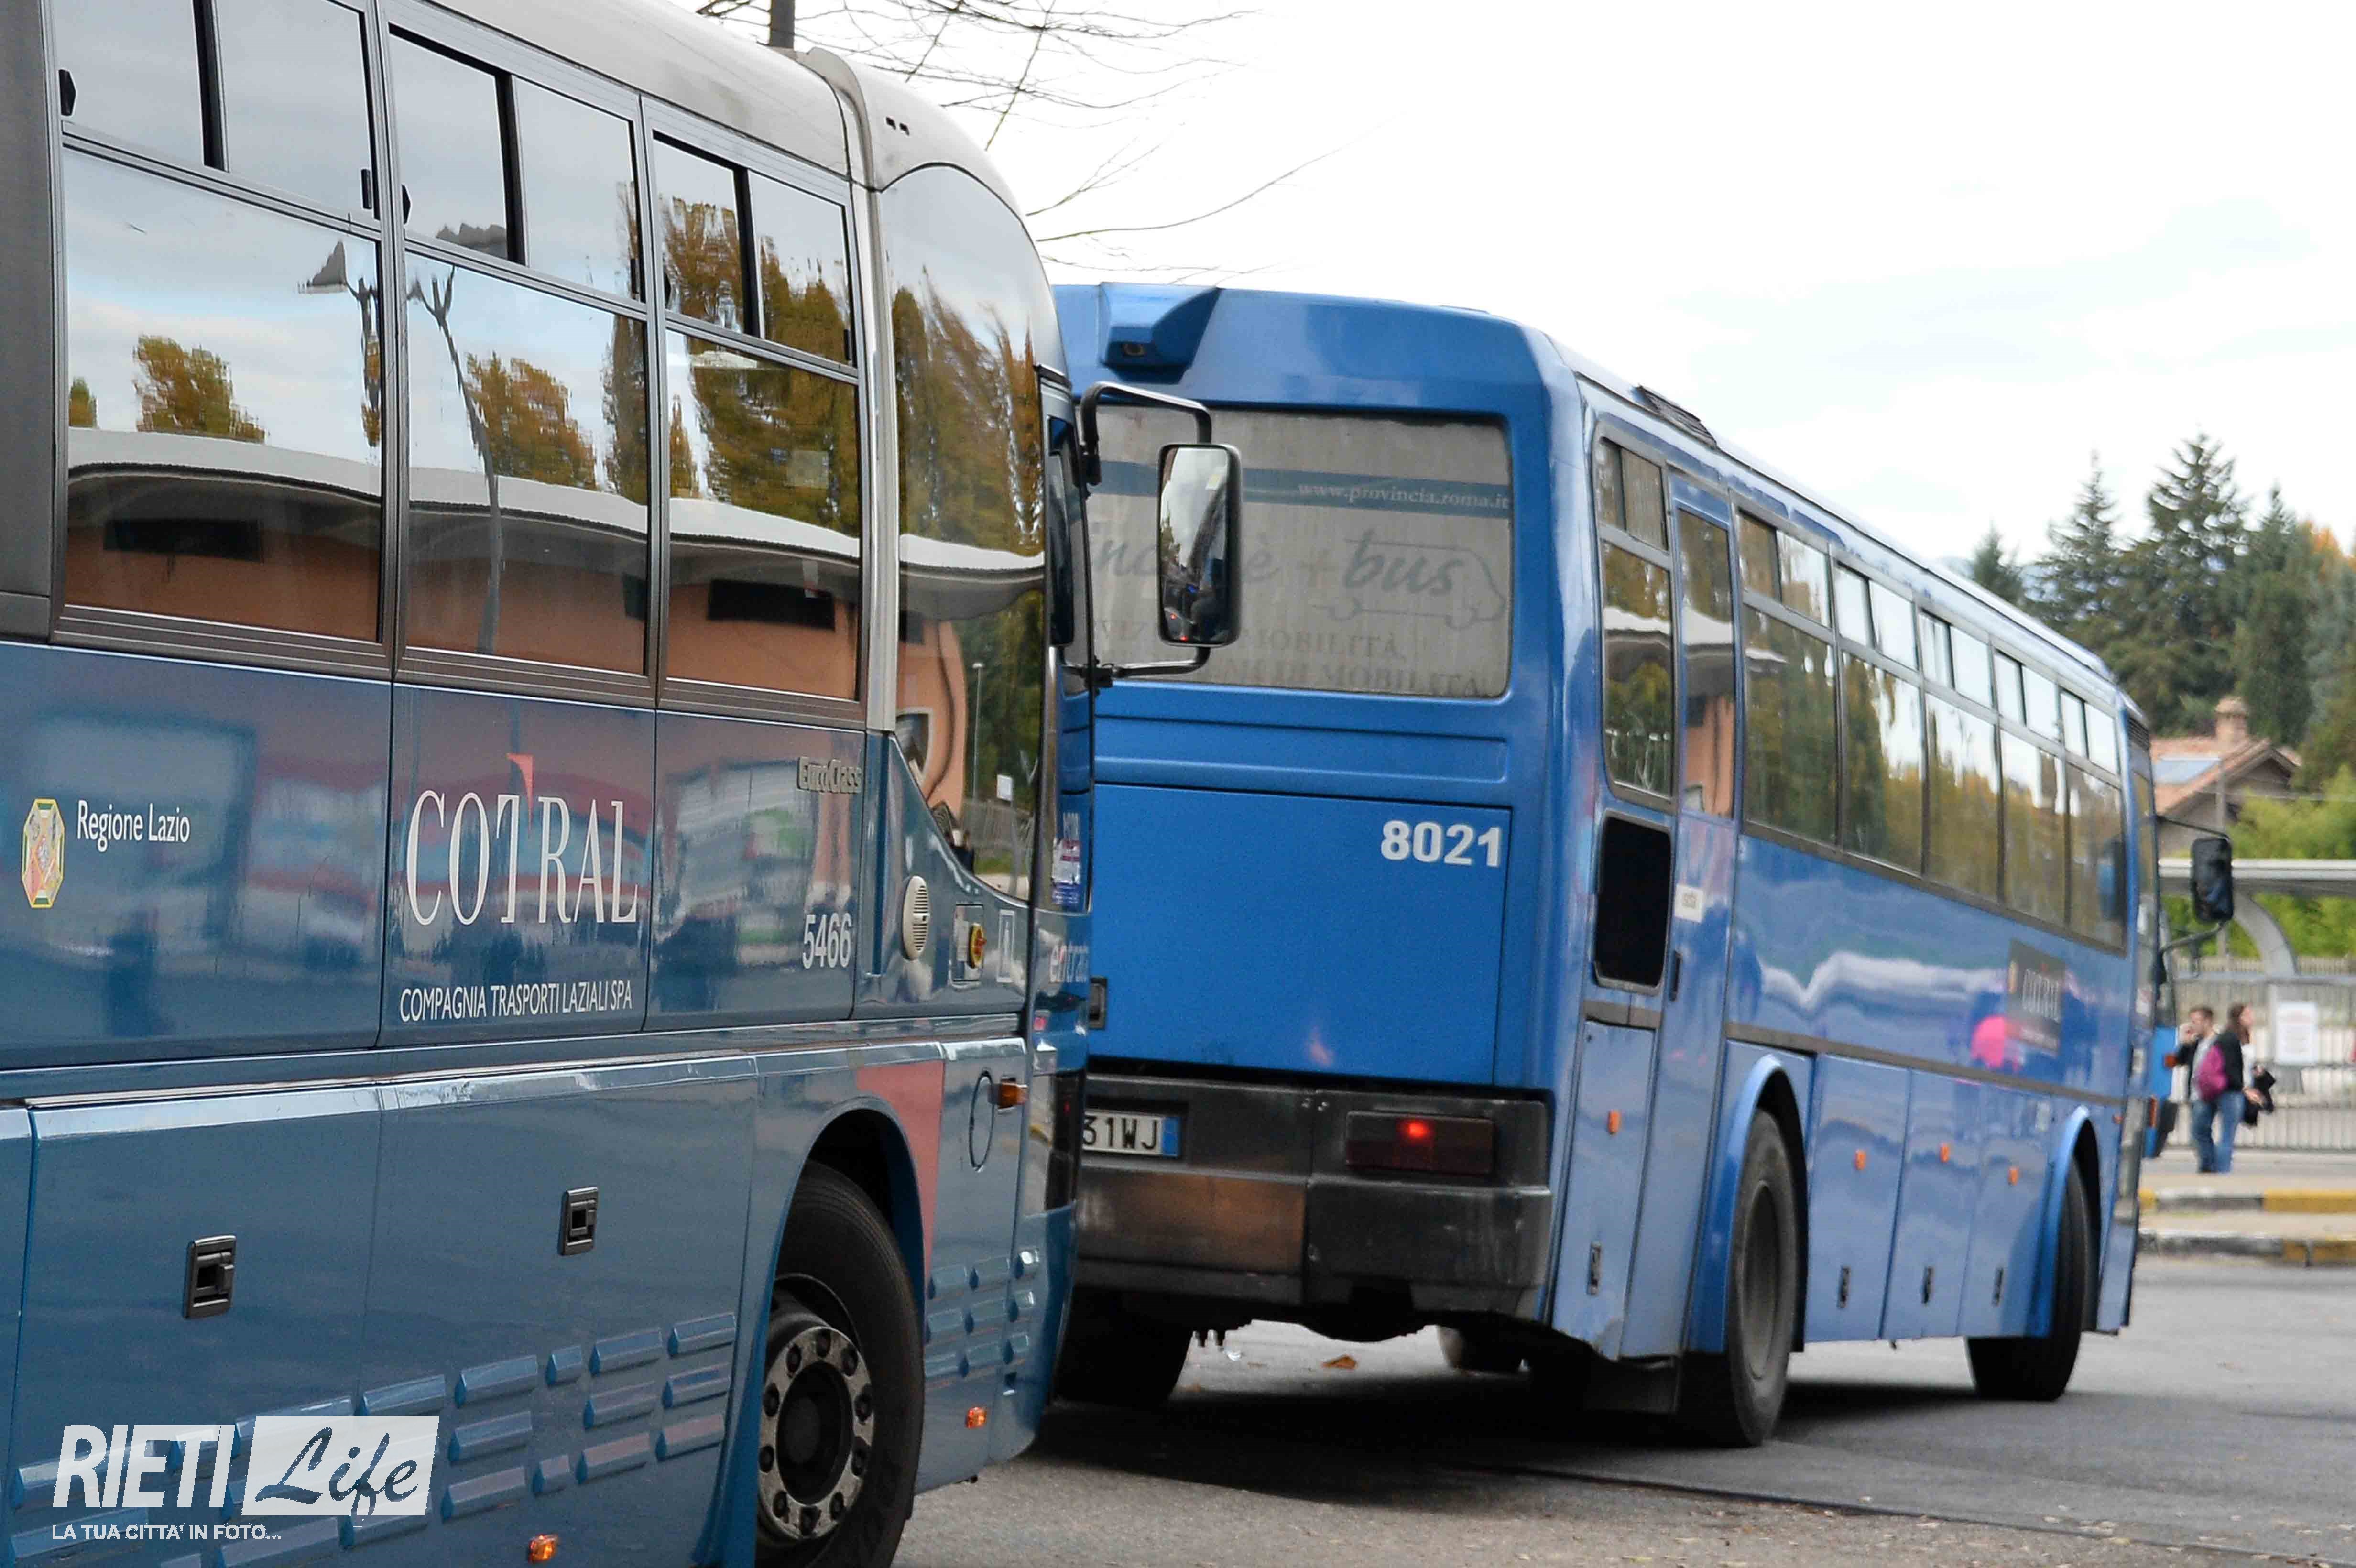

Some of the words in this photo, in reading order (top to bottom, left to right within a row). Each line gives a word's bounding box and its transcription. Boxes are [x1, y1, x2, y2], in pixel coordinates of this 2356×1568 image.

[1297, 482, 1509, 510] www.provincia.roma.it
[1342, 528, 1466, 597] bus
[77, 799, 143, 852] Regione
[148, 803, 191, 843] Lazio
[1381, 820, 1501, 868] 8021
[406, 789, 639, 926] COTRAL
[802, 912, 852, 969] 5466
[400, 985, 487, 1022] COMPAGNIA
[490, 982, 559, 1017] TRASPORTI
[562, 980, 608, 1013] LAZIALI
[610, 979, 633, 1010] SPA
